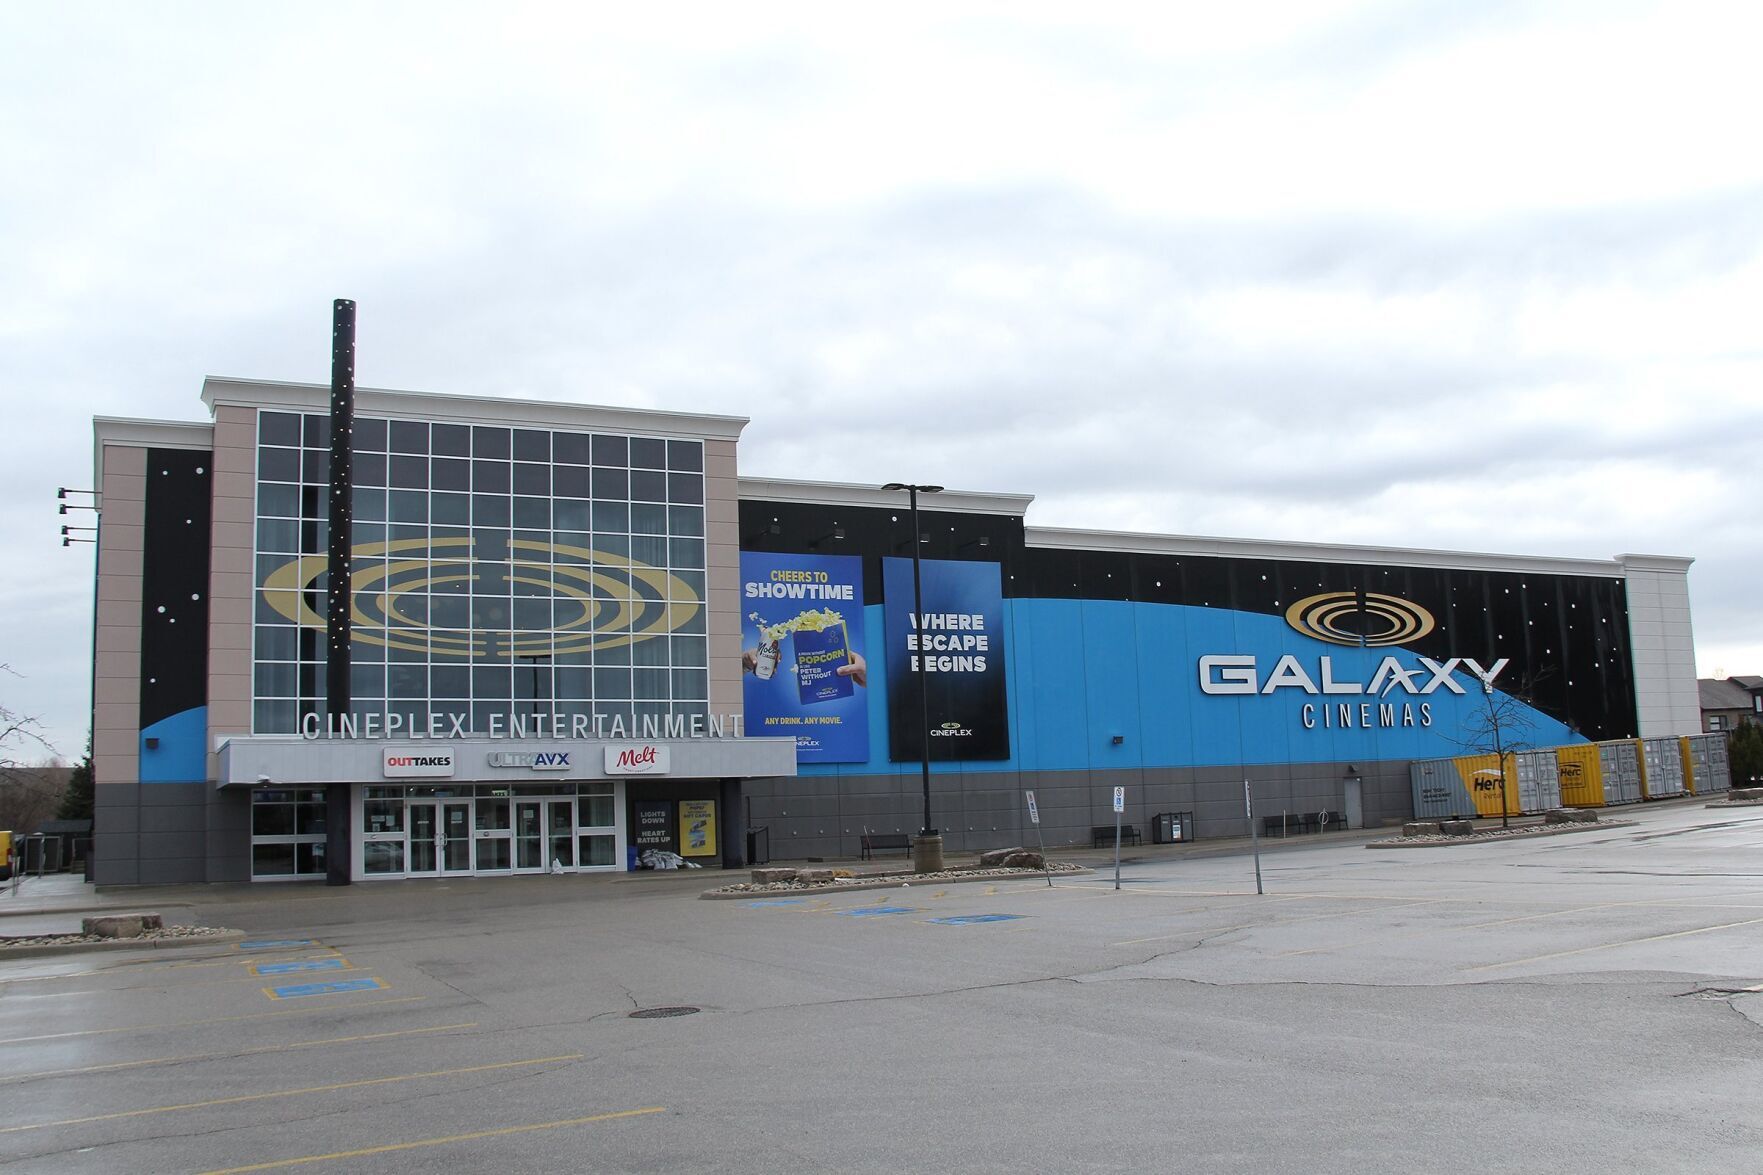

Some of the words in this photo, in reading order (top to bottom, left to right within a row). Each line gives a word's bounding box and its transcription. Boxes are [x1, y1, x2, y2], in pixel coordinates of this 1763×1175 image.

[771, 570, 811, 583] CHEERS
[814, 571, 828, 583] TO
[745, 582, 853, 600] SHOWTIME
[909, 613, 984, 630] WHERE
[907, 634, 989, 651] ESCAPE
[798, 648, 845, 664] POPCORN
[911, 655, 987, 672] BEGINS
[800, 667, 821, 675] PETER
[801, 671, 831, 680] WITHOUT
[1199, 654, 1510, 697] GALAXY
[765, 717, 779, 725] ANY
[780, 717, 803, 725] DRINK.
[804, 717, 819, 725] ANY
[820, 716, 843, 724] MOVIE.
[1302, 702, 1433, 729] CINEMAS
[302, 712, 467, 740] CINEPLEX
[489, 712, 744, 739] ENTERTAINMENT
[930, 729, 972, 737] CINEPLEX
[387, 756, 451, 767] OUTTAKES
[616, 746, 659, 767] Melt
[1560, 768, 1582, 777] Herc
